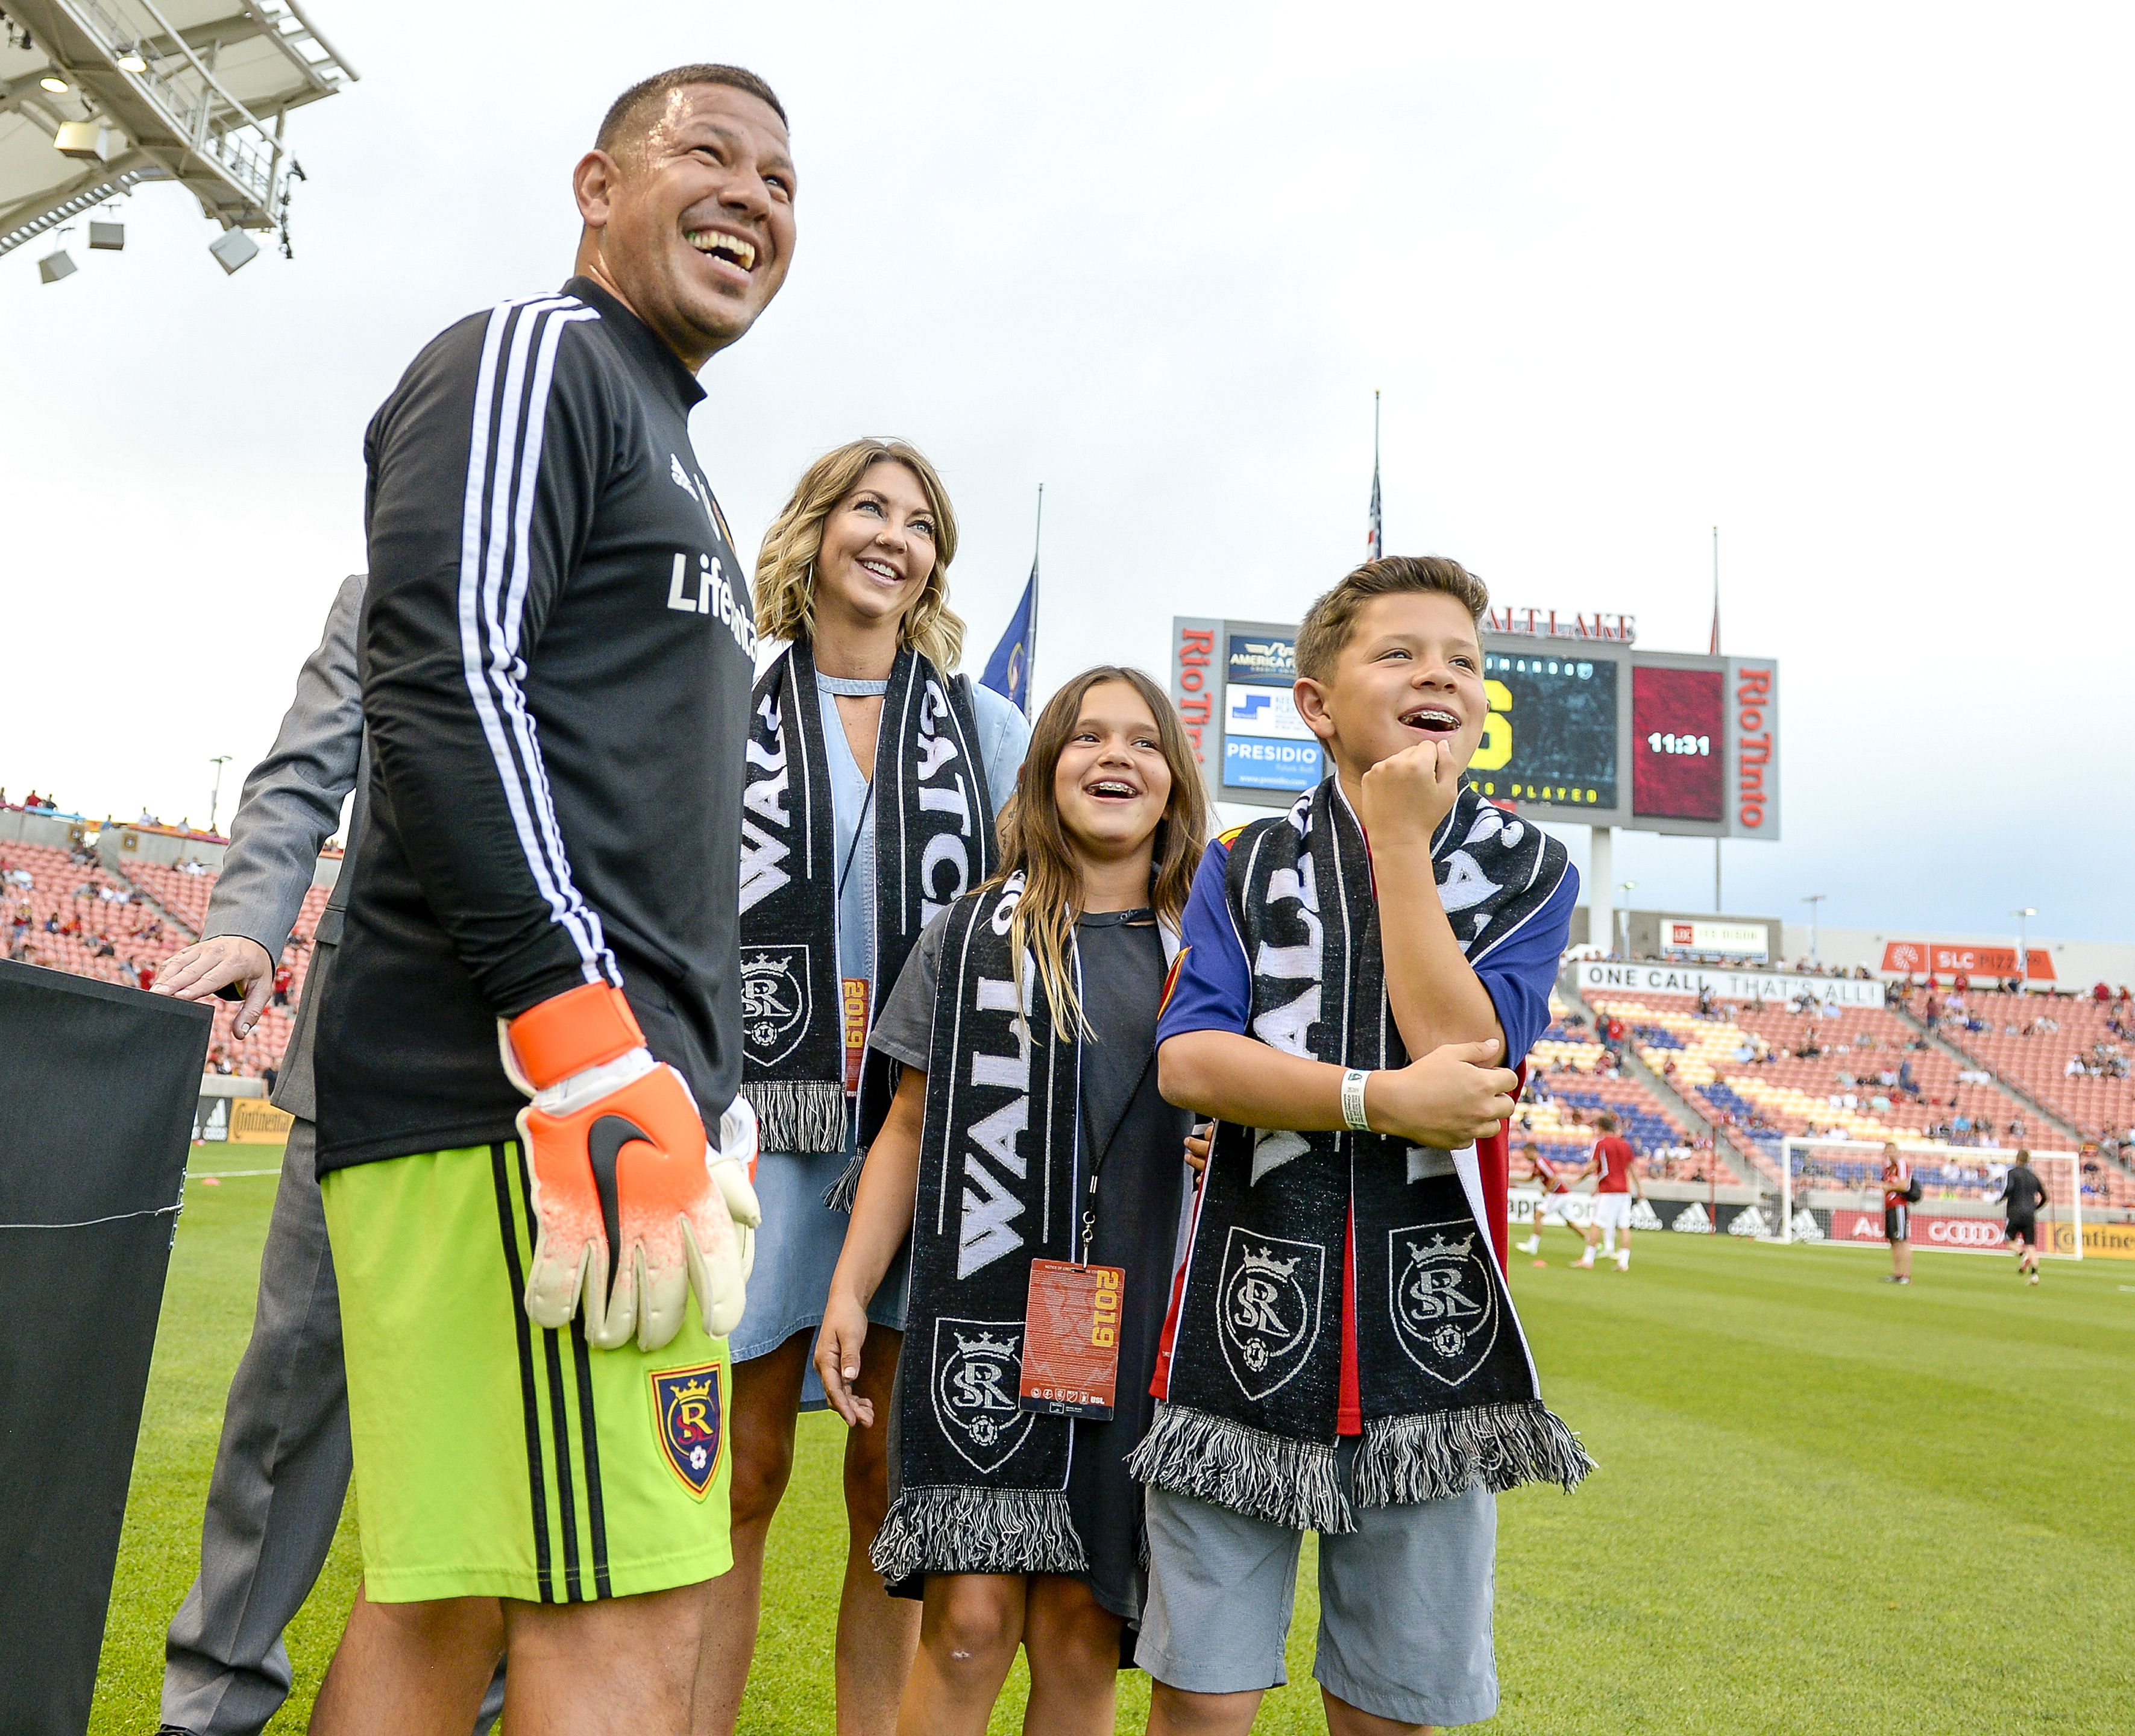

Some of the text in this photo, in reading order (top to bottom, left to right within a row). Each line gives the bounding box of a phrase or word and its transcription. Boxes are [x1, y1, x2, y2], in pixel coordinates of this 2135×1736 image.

[1481, 606, 1635, 641] ALT LAKE
[1230, 653, 1285, 667] AMERICA
[1485, 656, 1574, 676] IMANDO
[1180, 627, 1214, 764] RioTin
[1227, 743, 1317, 764] PRESIDIO
[1647, 732, 1710, 756] 11:31
[1511, 783, 1598, 804] PLAYED
[1937, 951, 1975, 970] SLC
[1589, 966, 1637, 987] ONE
[1649, 970, 1708, 992] CALL
[1729, 974, 1814, 997] THAT'S
[844, 981, 864, 1048] 2019
[1092, 1269, 1119, 1348] 2019
